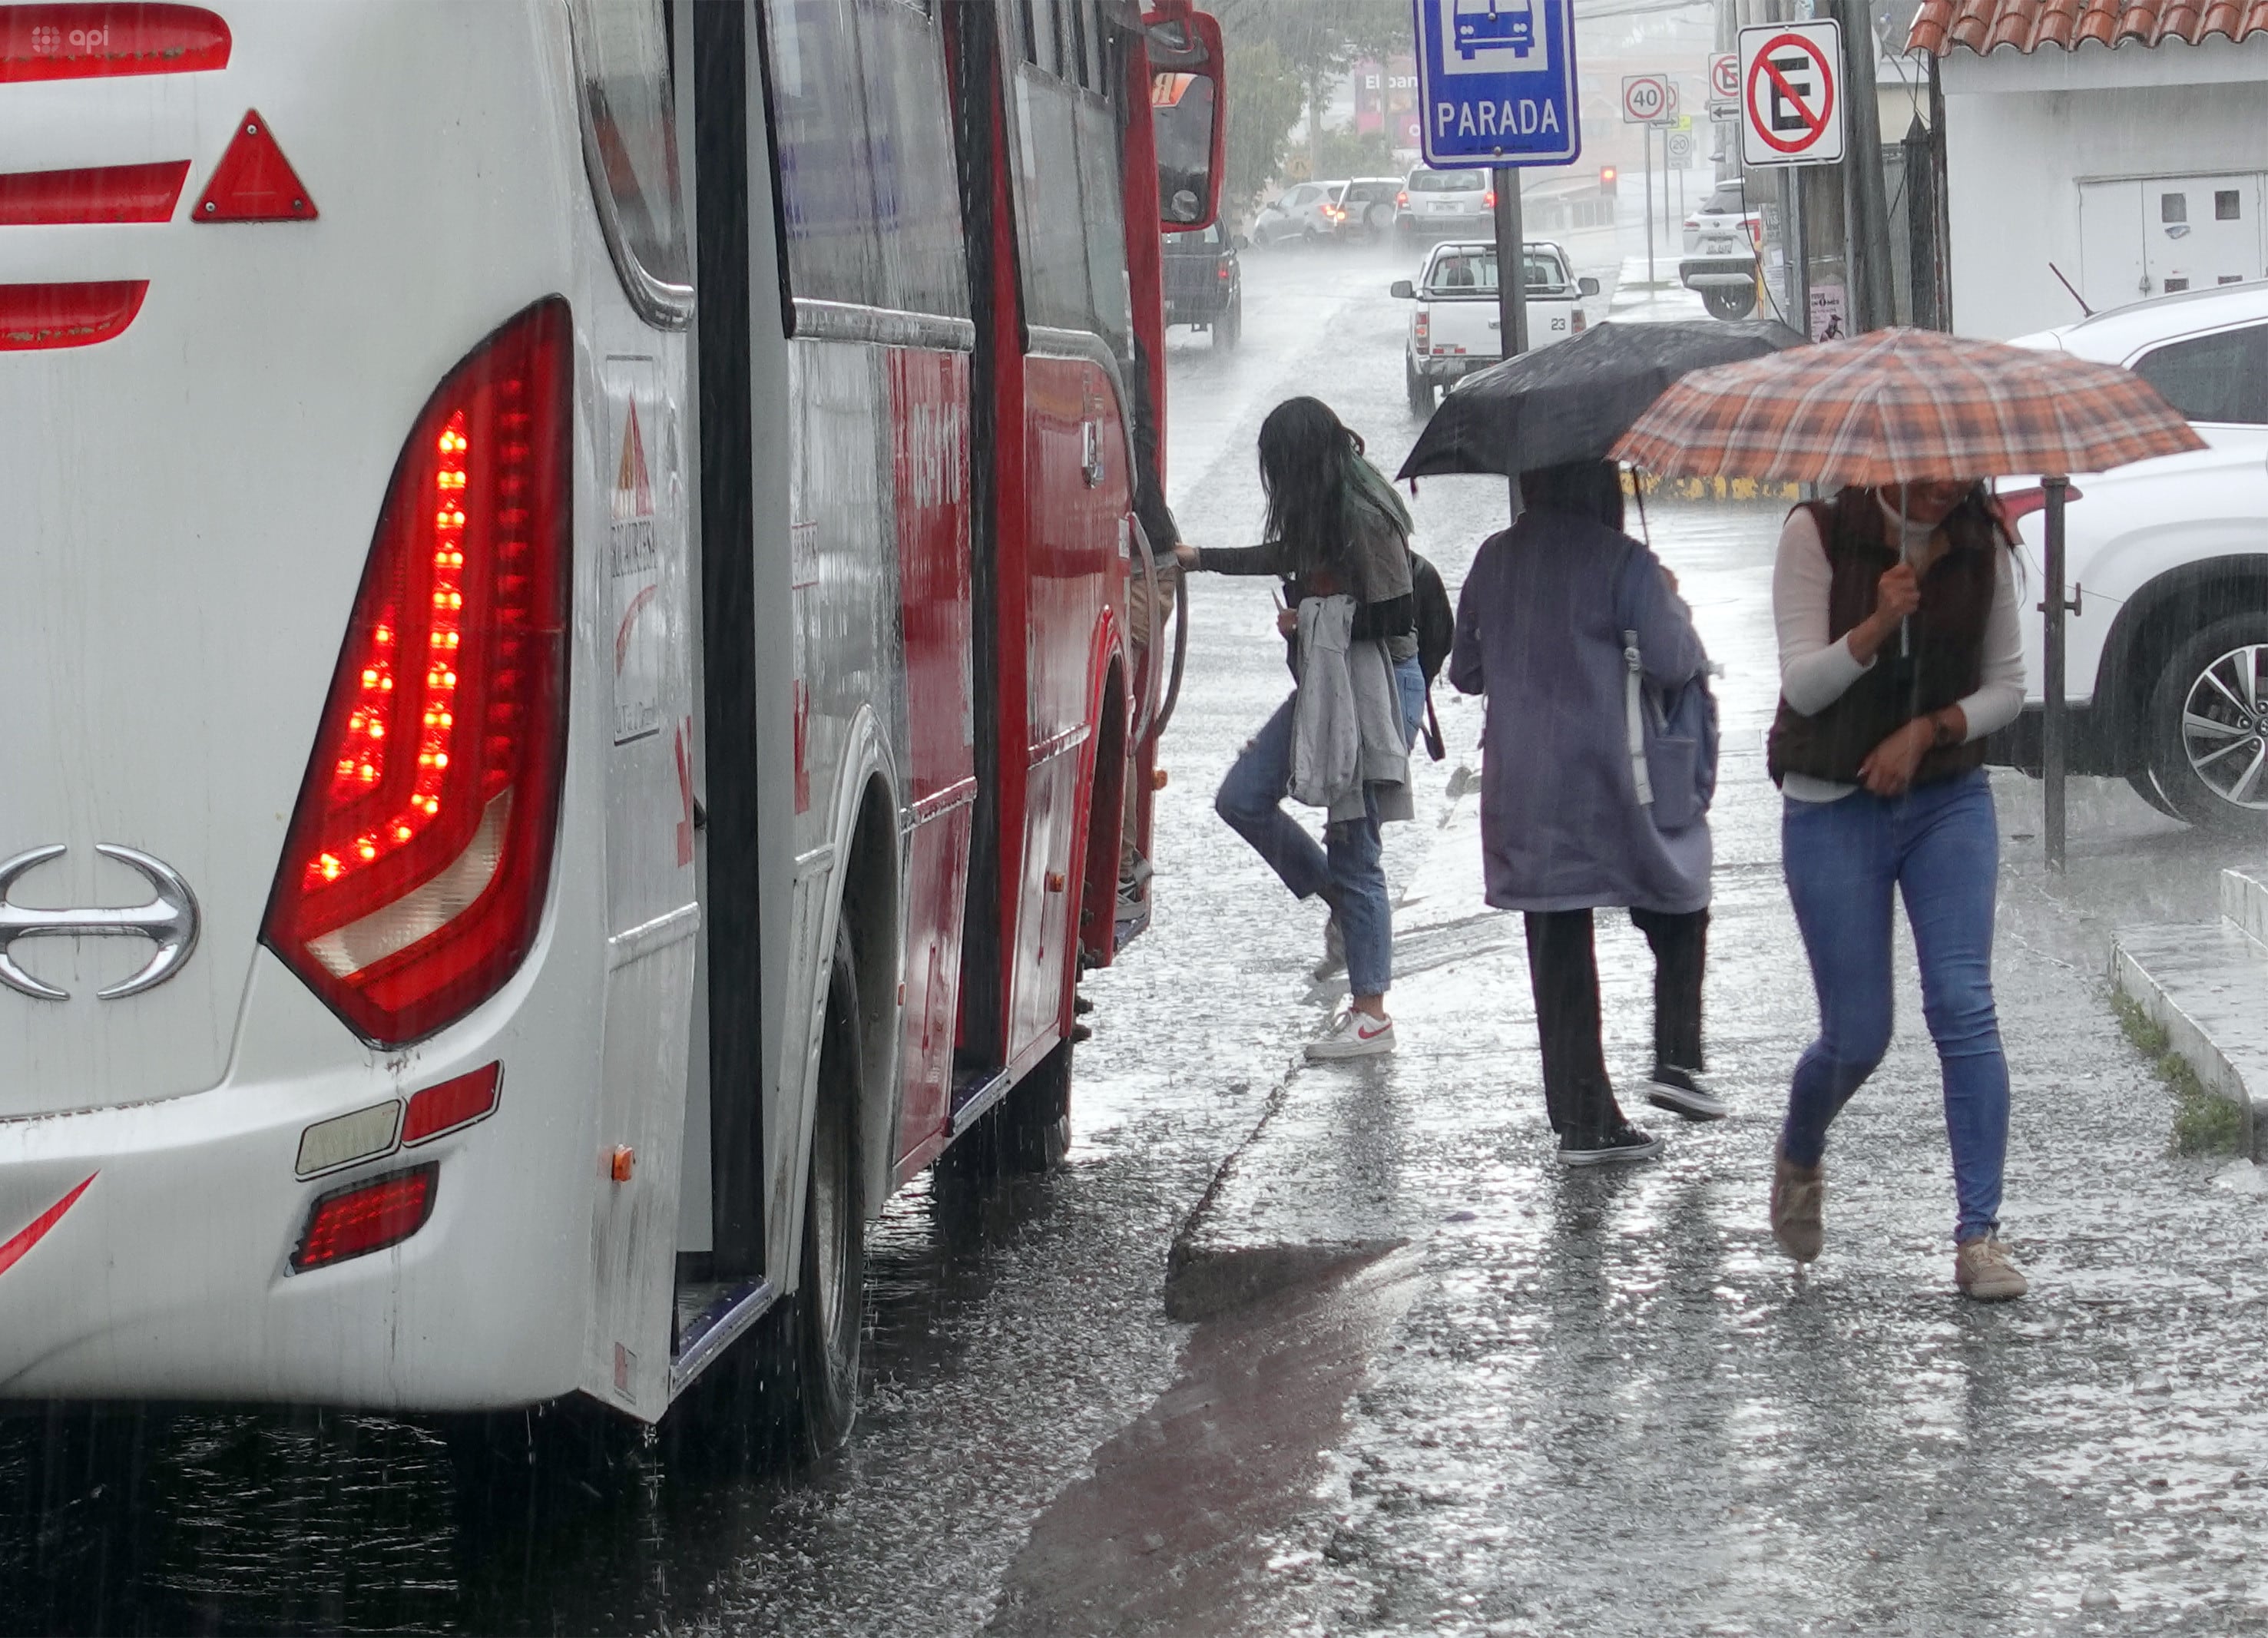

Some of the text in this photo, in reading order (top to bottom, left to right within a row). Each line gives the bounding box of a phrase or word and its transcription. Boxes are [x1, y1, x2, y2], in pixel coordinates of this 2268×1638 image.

[1366, 74, 1380, 89] El
[1634, 89, 1657, 107] 40
[1437, 98, 1560, 137] PARADA
[1673, 140, 1687, 150] 20
[1551, 318, 1566, 331] 23
